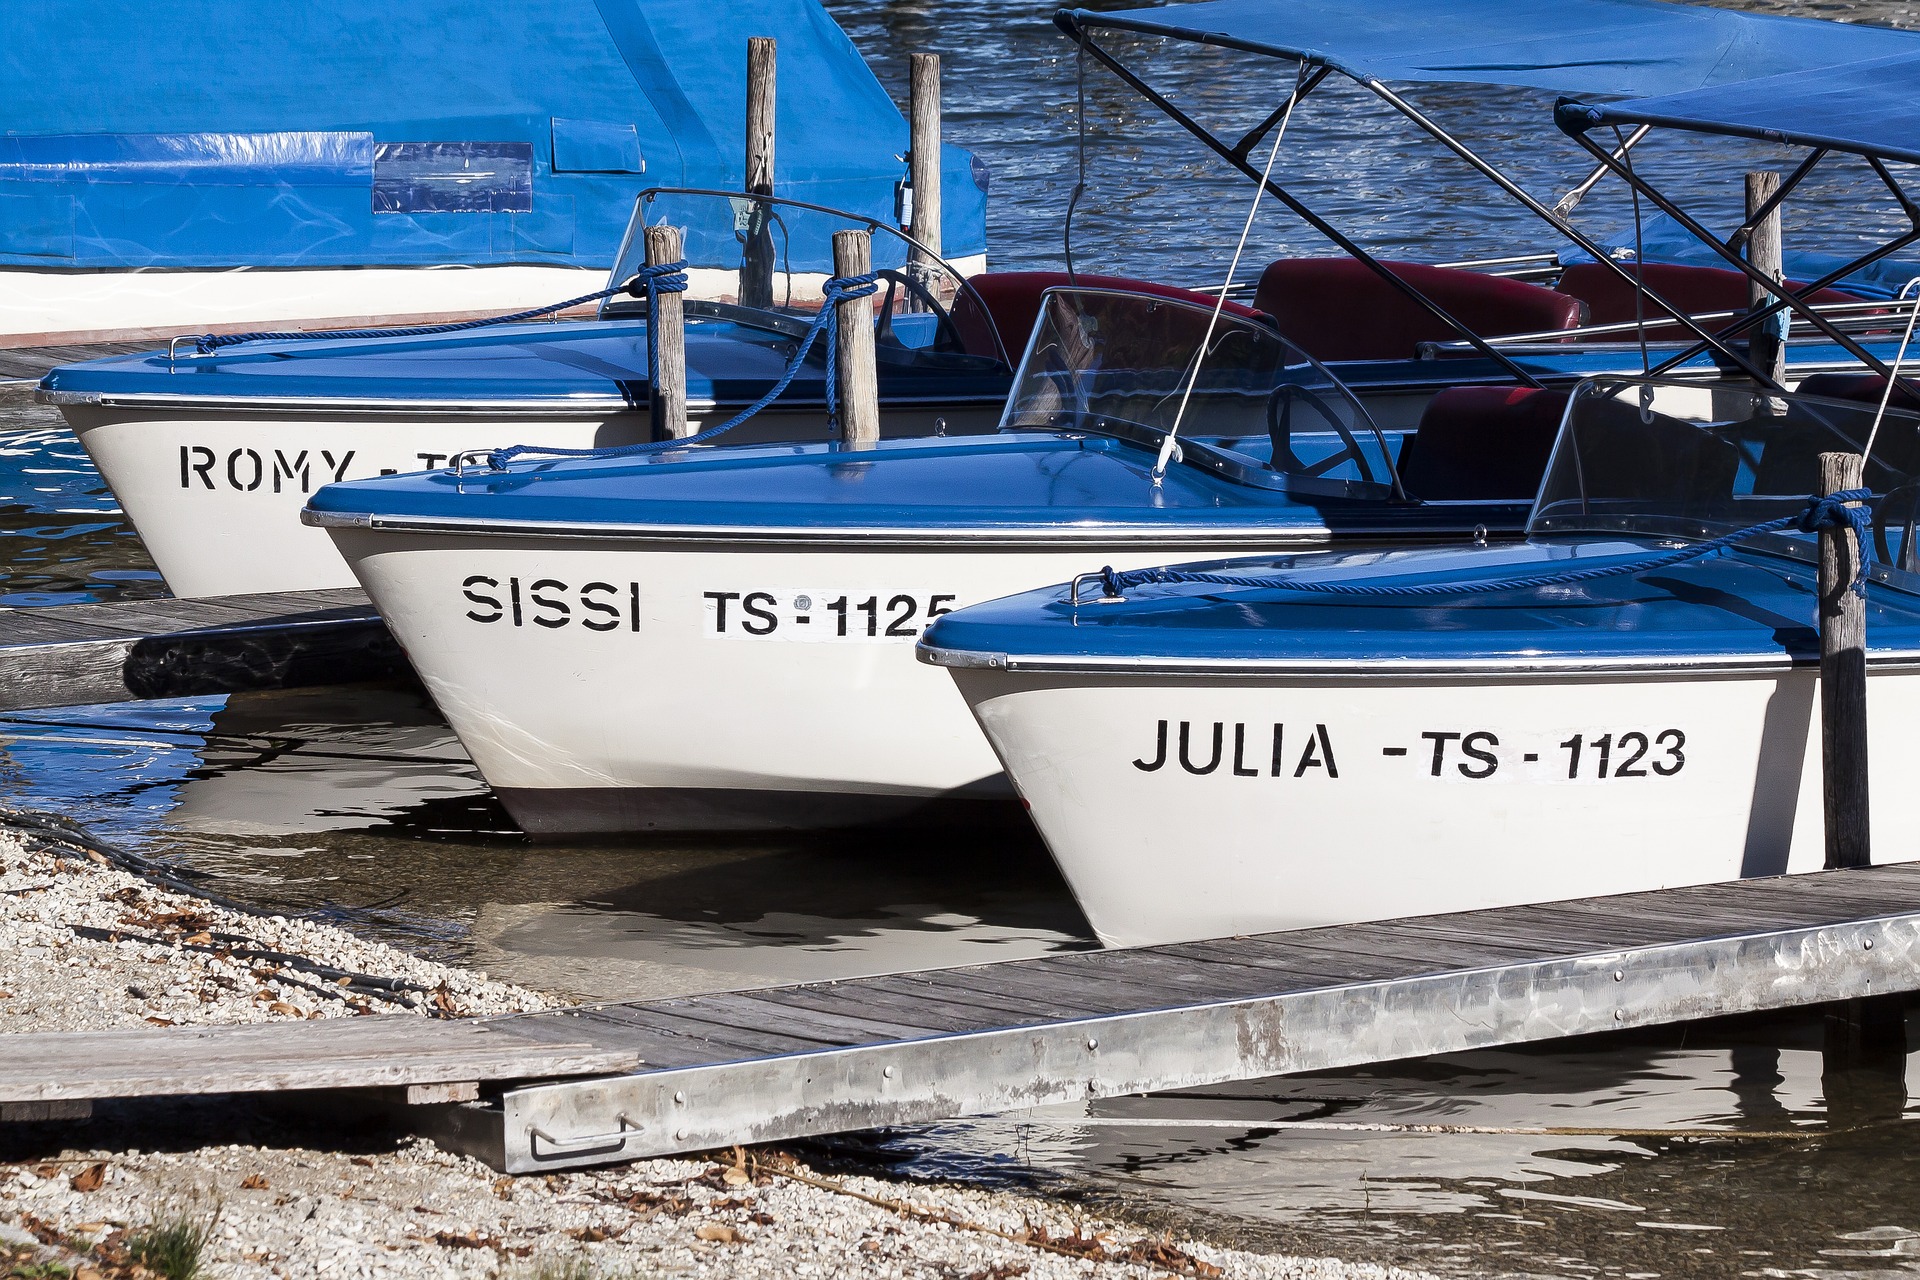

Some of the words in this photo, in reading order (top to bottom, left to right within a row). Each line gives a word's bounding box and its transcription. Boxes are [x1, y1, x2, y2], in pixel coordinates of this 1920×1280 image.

[180, 445, 356, 494] ROMY
[462, 575, 641, 633] SISSI
[703, 591, 779, 636] TS
[1131, 719, 1340, 779] JULIA
[1559, 728, 1687, 779] 1123
